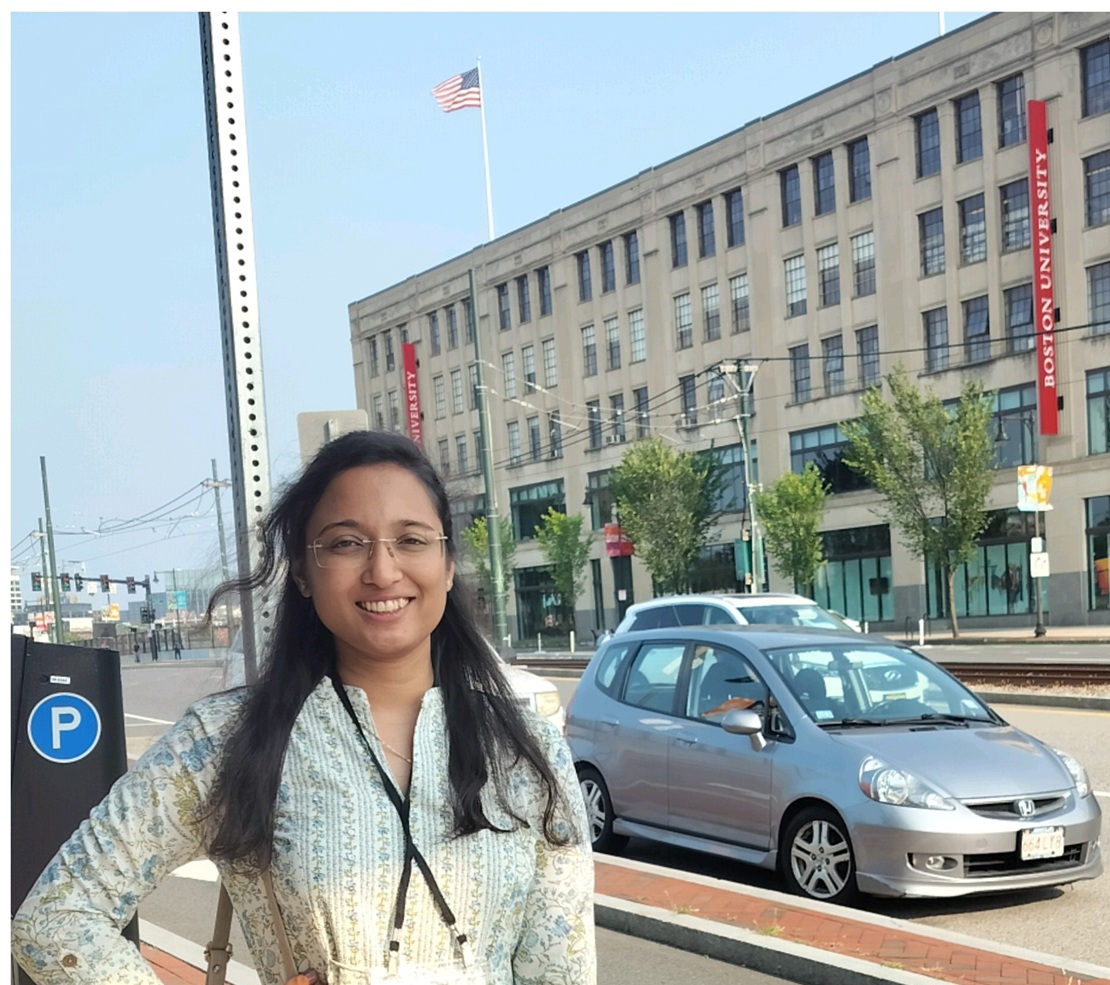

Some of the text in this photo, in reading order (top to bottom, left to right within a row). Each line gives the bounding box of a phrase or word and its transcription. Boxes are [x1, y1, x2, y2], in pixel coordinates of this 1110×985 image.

[1036, 149, 1055, 388] BOSTON UNIVERSITY
[50, 705, 82, 750] P
